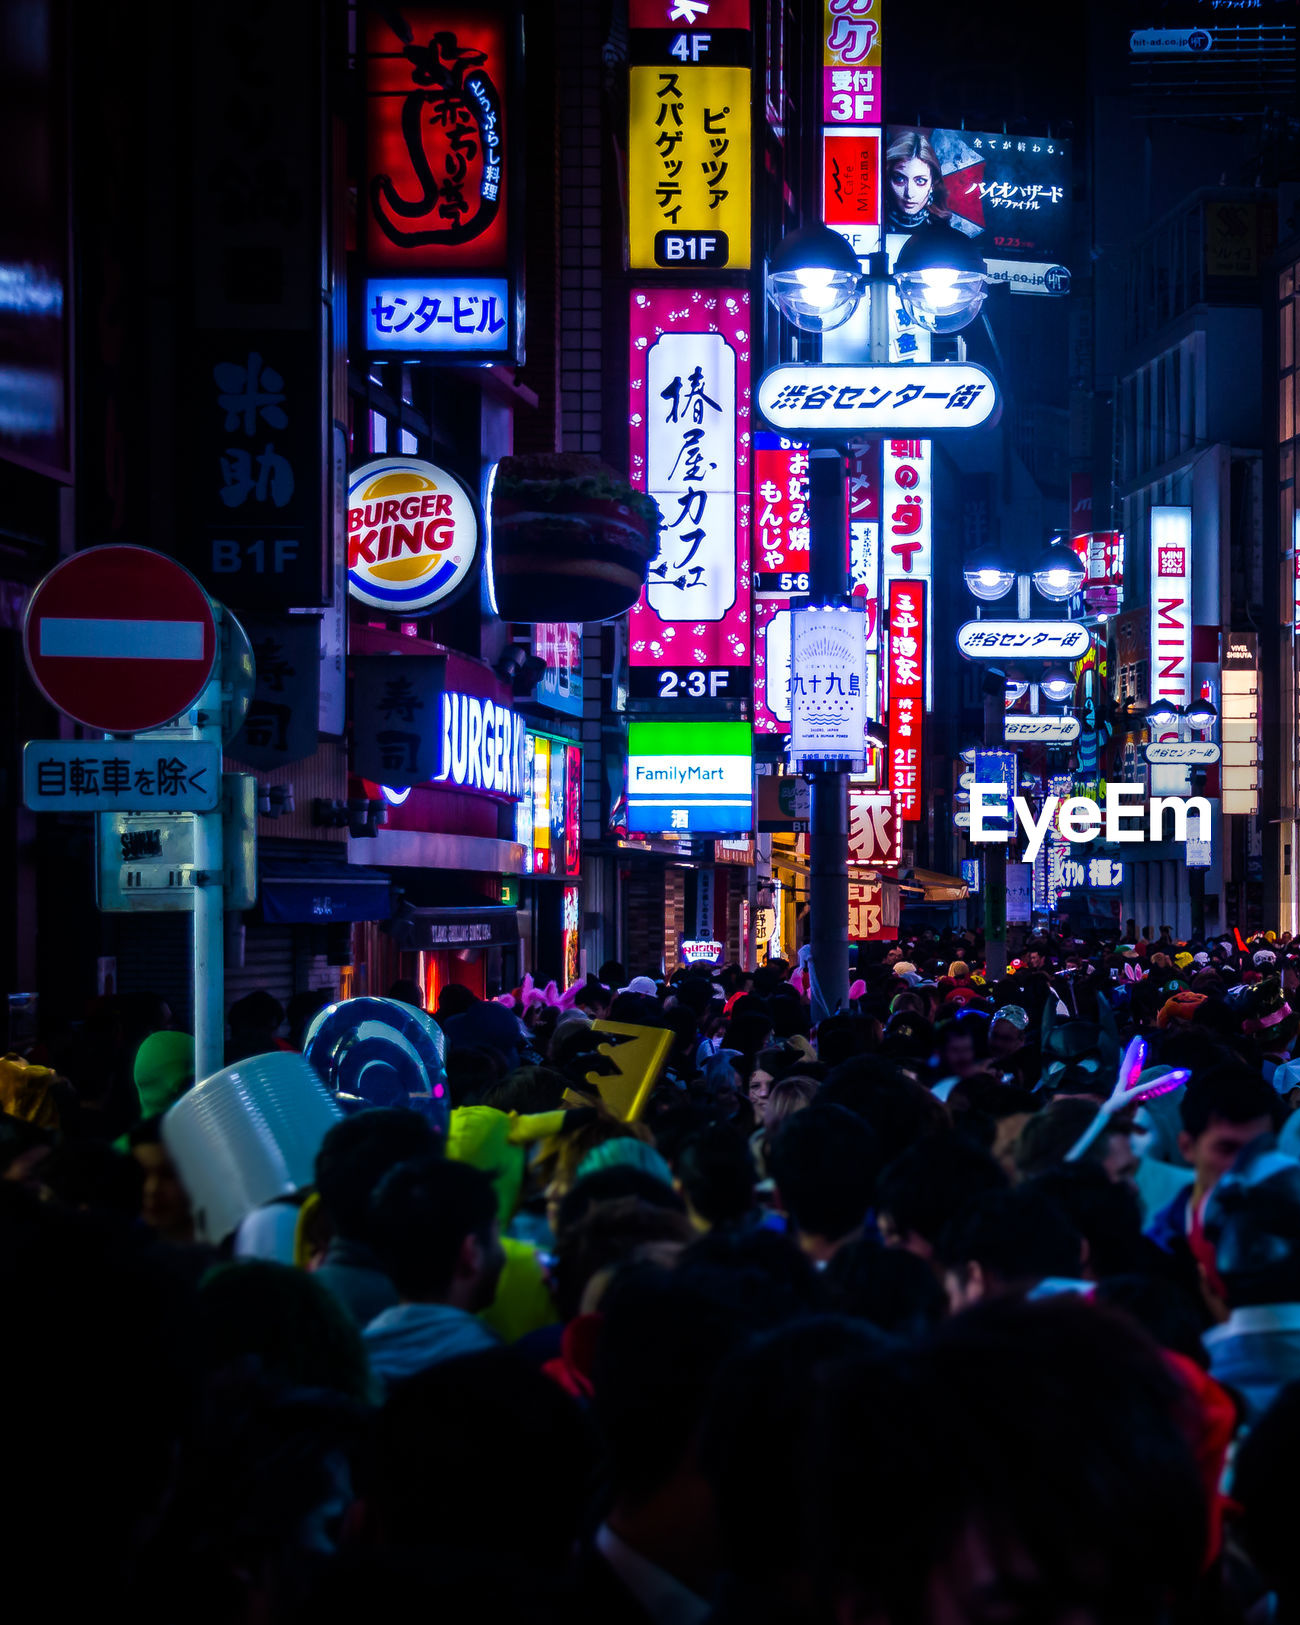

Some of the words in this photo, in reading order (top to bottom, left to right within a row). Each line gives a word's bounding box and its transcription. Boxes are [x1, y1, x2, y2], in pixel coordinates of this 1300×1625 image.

[672, 35, 711, 61] 4F
[831, 71, 874, 92] 受付
[831, 94, 874, 120] 3F
[656, 74, 684, 225] スパゲッティ
[701, 106, 730, 210] ピッツァ
[844, 165, 854, 196] Cafe
[857, 151, 870, 211] Miyama
[965, 182, 1064, 204] バイオハザード
[667, 237, 717, 260] B1F
[372, 295, 506, 334] センタービル
[770, 383, 986, 410] 渋谷センター街
[660, 366, 723, 587] 椿屋カフェ
[349, 494, 454, 531] BURGER
[759, 480, 785, 570] もんじゃ
[349, 517, 456, 569] KING
[211, 539, 300, 575] B1F
[964, 631, 1081, 648] 渋谷センター街
[794, 672, 861, 697] 九十九島
[1005, 722, 1076, 737] 谷センター街
[894, 749, 917, 764] 2F
[37, 757, 208, 797] 自転車を除く
[636, 766, 724, 784] FamilyMart
[894, 772, 917, 787] 3F
[671, 809, 689, 828] 酒
[793, 822, 810, 832] B1
